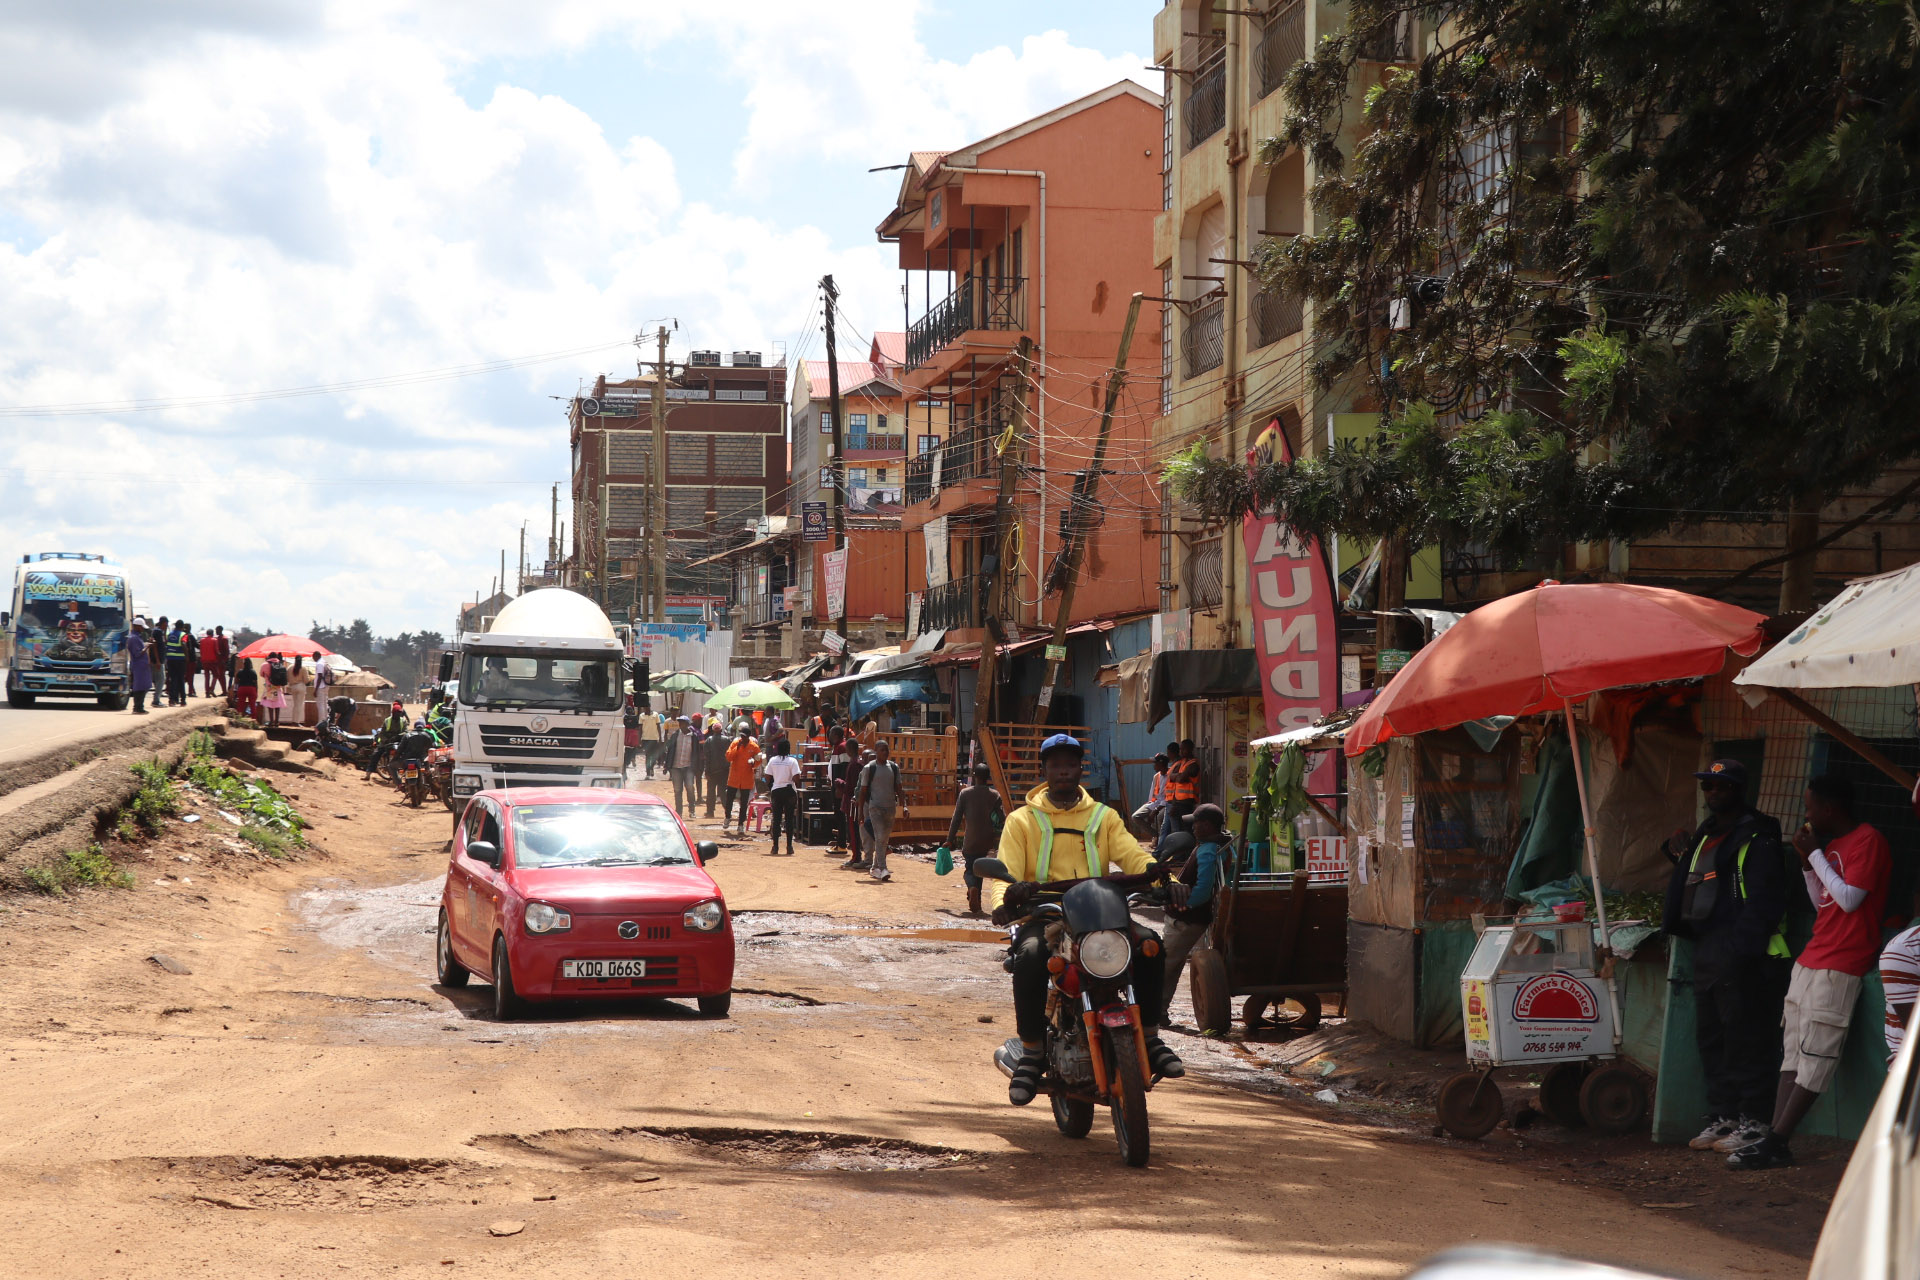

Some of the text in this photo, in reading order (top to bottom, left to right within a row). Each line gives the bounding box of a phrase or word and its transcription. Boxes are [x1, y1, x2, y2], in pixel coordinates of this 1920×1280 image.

[30, 585, 115, 596] WARWICK
[658, 624, 699, 633] Milk Bar
[509, 737, 560, 746] SHACMA
[1307, 862, 1349, 884] PRIN
[576, 961, 603, 977] KDQ
[1519, 978, 1590, 1014] Farmer's Choice
[1523, 1042, 1546, 1052] 0768
